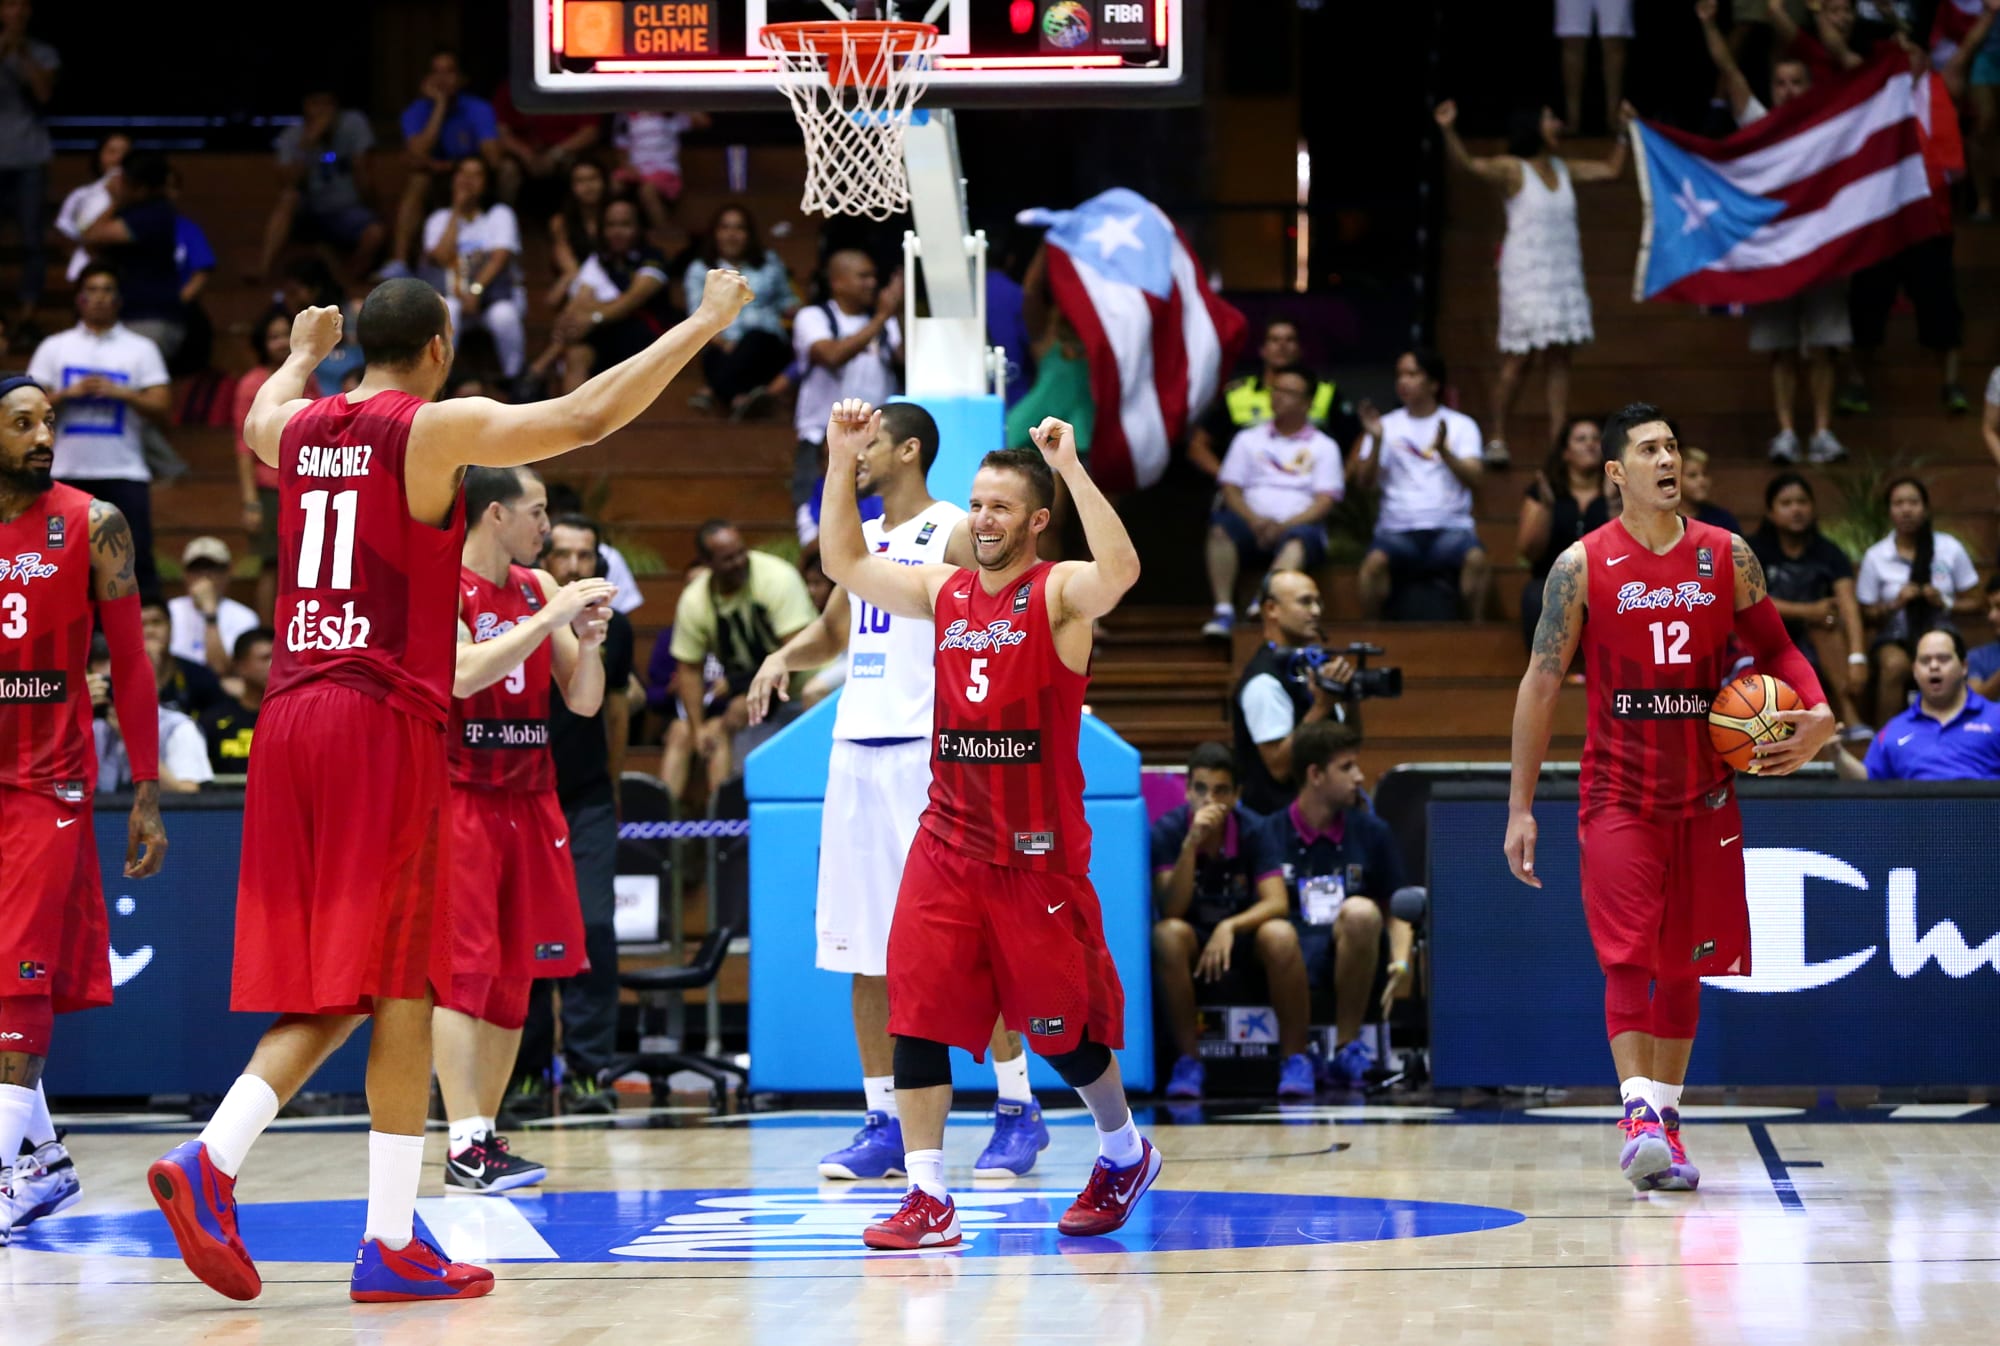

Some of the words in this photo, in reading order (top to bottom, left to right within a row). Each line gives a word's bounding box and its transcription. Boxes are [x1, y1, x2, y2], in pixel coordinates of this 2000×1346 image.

[634, 3, 708, 27] CLEAN
[1104, 4, 1143, 23] FIBA
[634, 28, 709, 53] GAME
[297, 445, 373, 478] SANCHEZ
[298, 489, 359, 590] 11
[10, 552, 58, 586] Rico
[1617, 581, 1674, 614] Puerto
[1674, 581, 1715, 612] Rico
[286, 599, 371, 653] dish
[938, 619, 987, 652] Puerto
[983, 620, 1027, 654] Rico
[1648, 621, 1692, 665] 12
[965, 658, 989, 703] 5
[1699, 847, 2000, 993] Ch
